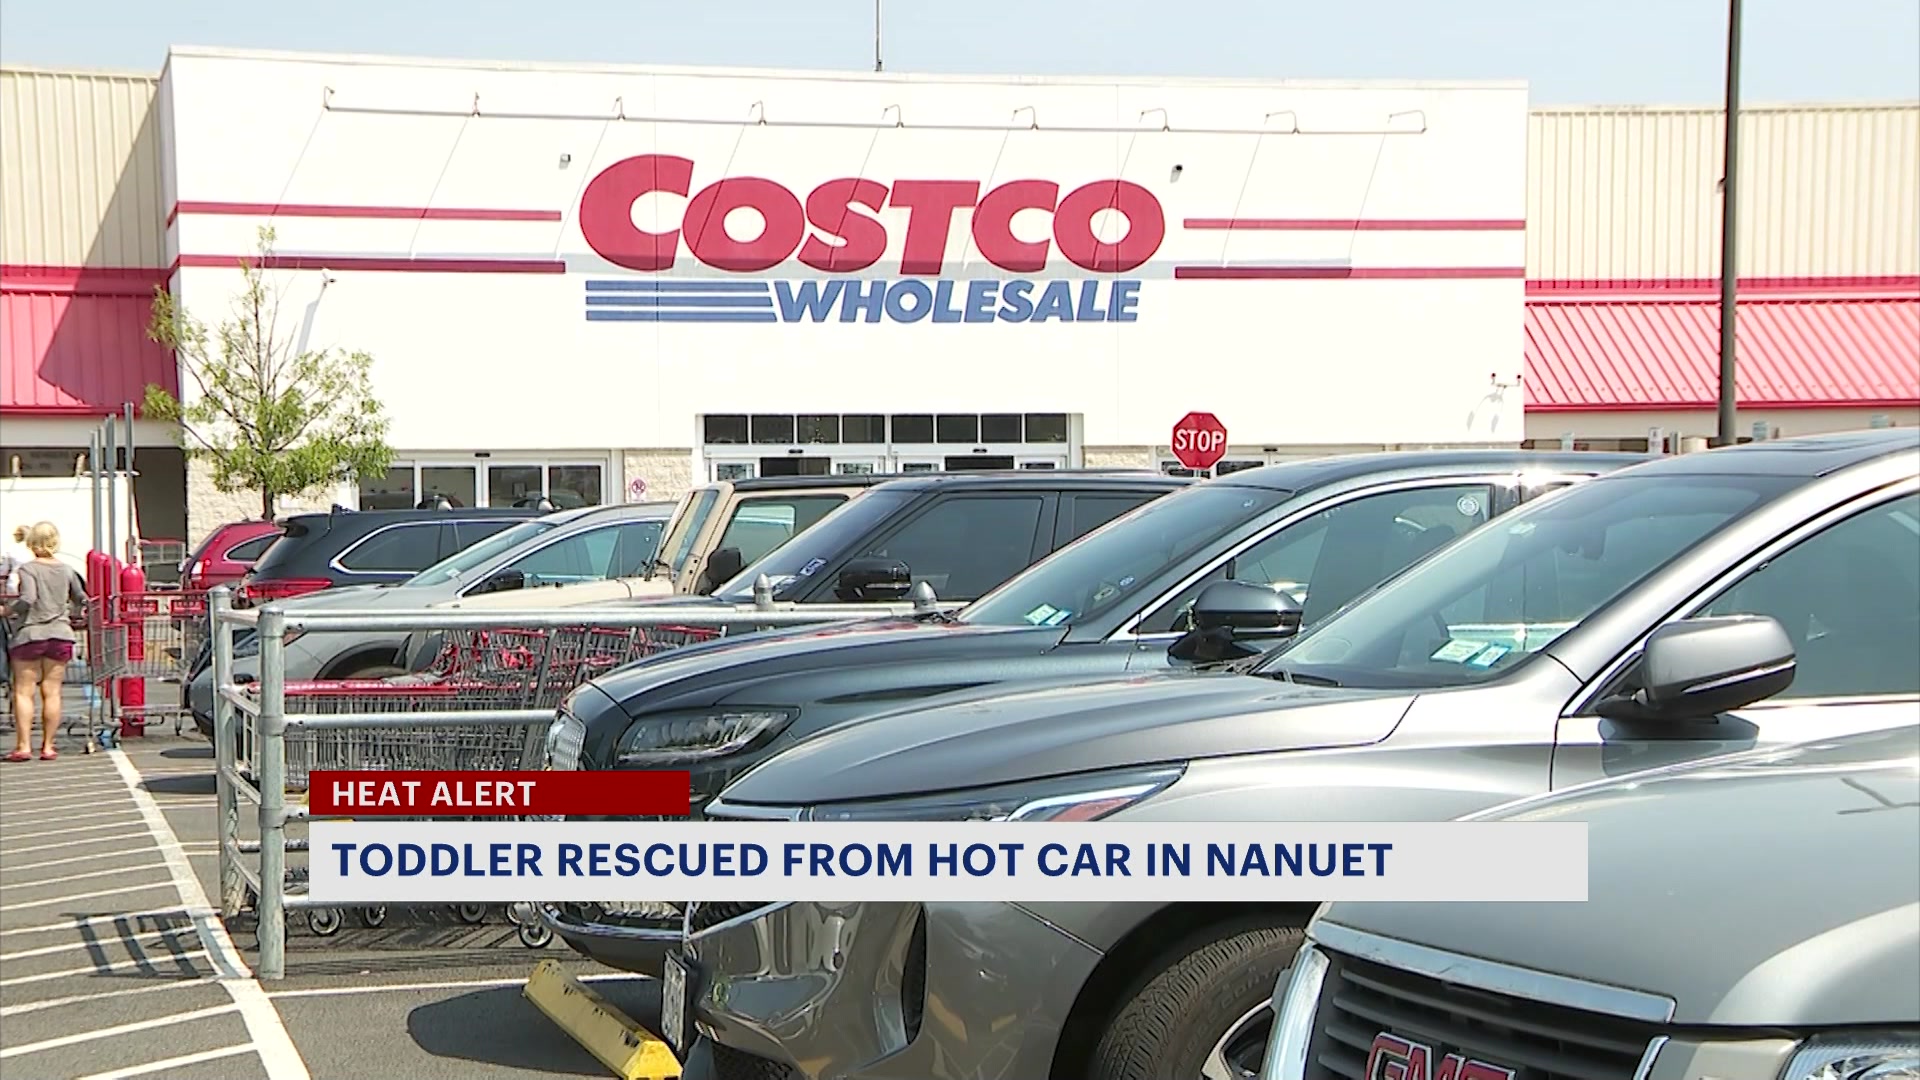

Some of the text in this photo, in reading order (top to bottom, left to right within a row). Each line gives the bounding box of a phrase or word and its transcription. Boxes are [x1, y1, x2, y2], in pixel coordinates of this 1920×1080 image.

[579, 153, 1166, 275] COSTCO
[773, 279, 1141, 323] WHOLESALE
[1174, 428, 1225, 452] STOP
